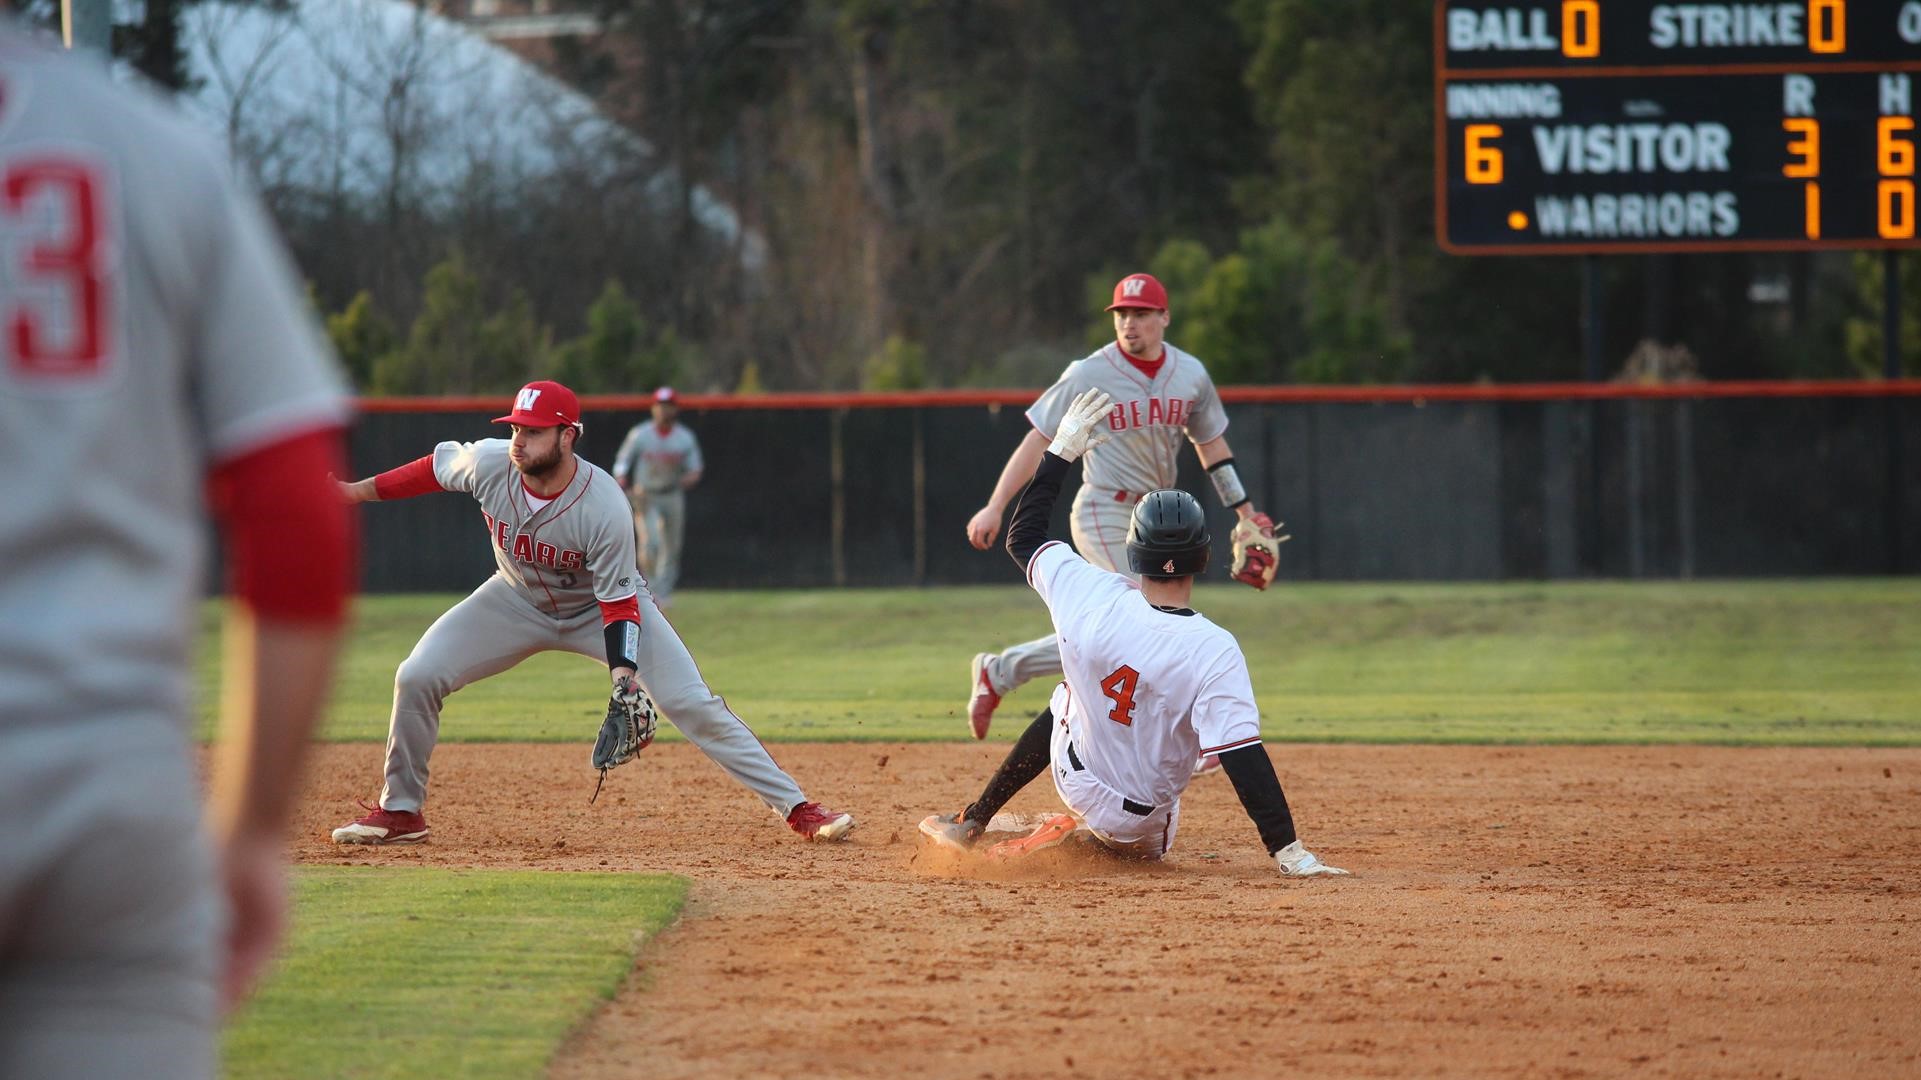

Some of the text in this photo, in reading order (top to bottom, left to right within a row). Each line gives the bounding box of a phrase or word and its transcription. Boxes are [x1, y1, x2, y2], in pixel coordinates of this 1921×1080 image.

[1446, 8, 1558, 51] BALL
[1561, 0, 1600, 58] 0
[1649, 4, 1806, 48] STRIKE
[1807, 0, 1846, 54] 0
[1446, 73, 1912, 119] INNING R H
[1464, 116, 1916, 184] 6 VISITOR 3 6
[1534, 192, 1741, 238] WARRIORS
[1877, 179, 1916, 240] 0
[4, 152, 108, 382] 3
[1122, 279, 1146, 297] W
[514, 388, 541, 411] W
[1162, 559, 1175, 573] 4
[1100, 664, 1140, 727] 4
